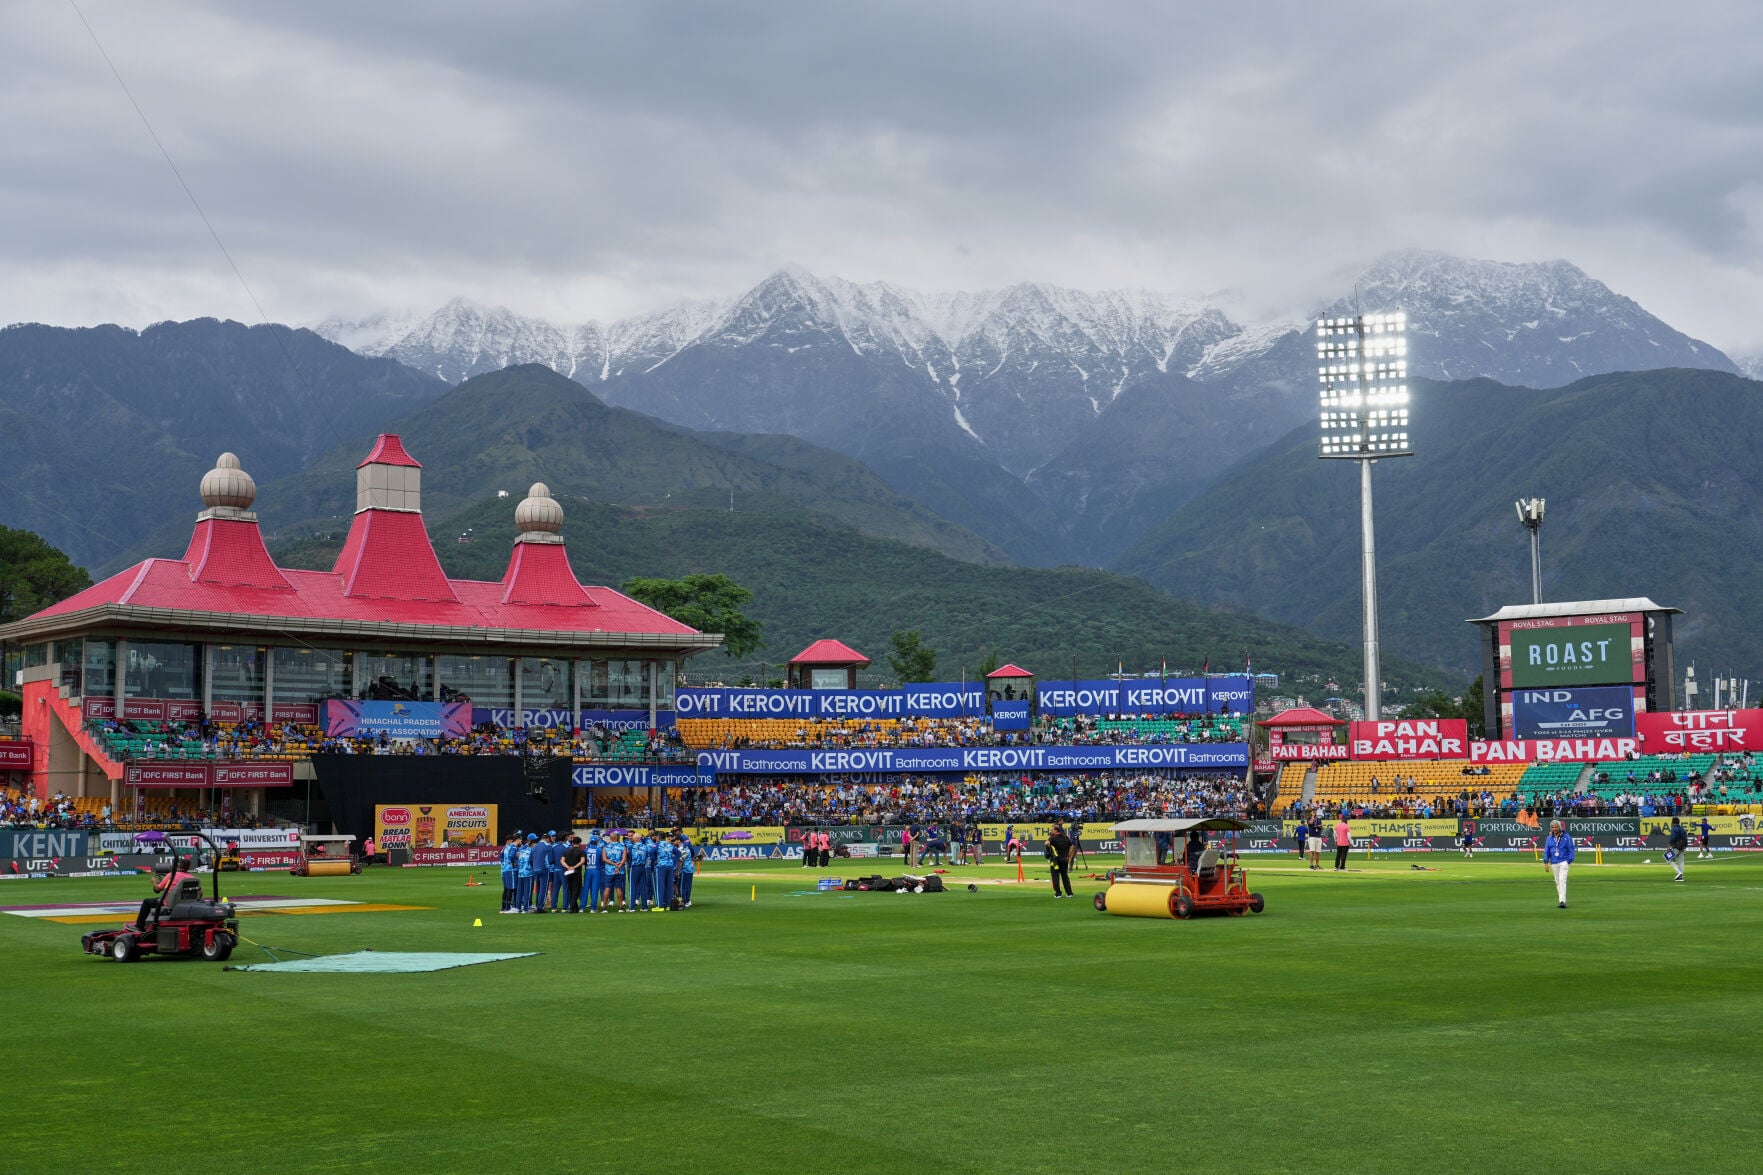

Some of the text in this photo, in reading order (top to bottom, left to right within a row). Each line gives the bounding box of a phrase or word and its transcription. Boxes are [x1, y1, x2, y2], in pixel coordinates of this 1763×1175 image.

[1513, 621, 1535, 629] ROYAL
[1584, 616, 1607, 624] ROYAL
[1529, 641, 1609, 665] ROAST
[907, 691, 982, 710] KEROVIT
[1039, 689, 1120, 708] KEROVIT
[1127, 688, 1205, 706] KEROVIT
[1211, 691, 1251, 701] KEROVIT
[1524, 691, 1572, 704] IND
[676, 694, 721, 712] OVIT
[729, 694, 813, 713] KEROVIT
[820, 695, 903, 713] KEROVIT
[994, 710, 1027, 720] KEROVIT
[1568, 708, 1623, 721] AFG
[1671, 711, 1737, 729] पान
[361, 717, 402, 725] HIMACHAL
[1377, 721, 1438, 737] PAN
[1663, 728, 1747, 747] बहार
[1272, 745, 1347, 758] PAN BAHAR
[1353, 738, 1462, 755] BAHAR
[1471, 739, 1636, 761] PAN BAHAR
[697, 748, 1246, 770] OVIT Bathrooms KEROVIT Bathrooms KEROVIT Bathrooms KEROVIT Bathrooms
[229, 771, 246, 779] IDFC
[651, 774, 712, 784] Bathrooms
[447, 820, 487, 828] BISCUITS
[1370, 823, 1422, 833] THAMES
[1569, 822, 1635, 832] PORTRONICS
[382, 828, 410, 836] BREAD
[102, 839, 141, 848] CHITKARA
[242, 834, 288, 843] UNIVERSITY
[380, 834, 411, 843] MATLAB
[1249, 837, 1279, 848] UTEX
[1351, 837, 1380, 848] UTEX
[1403, 837, 1433, 847] UTEX
[1508, 836, 1539, 847] UTEX
[1616, 835, 1648, 846] UTEX
[1729, 835, 1761, 846] UTEX
[12, 833, 81, 858] KENT
[422, 852, 444, 860] FIRST
[446, 852, 465, 860] Bank
[480, 850, 499, 858] IDFC
[710, 846, 766, 858] ASTRAL
[26, 857, 60, 871] UTEX
[87, 855, 120, 869] UTEX
[257, 856, 281, 865] FIRST
[586, 853, 597, 865] 50
